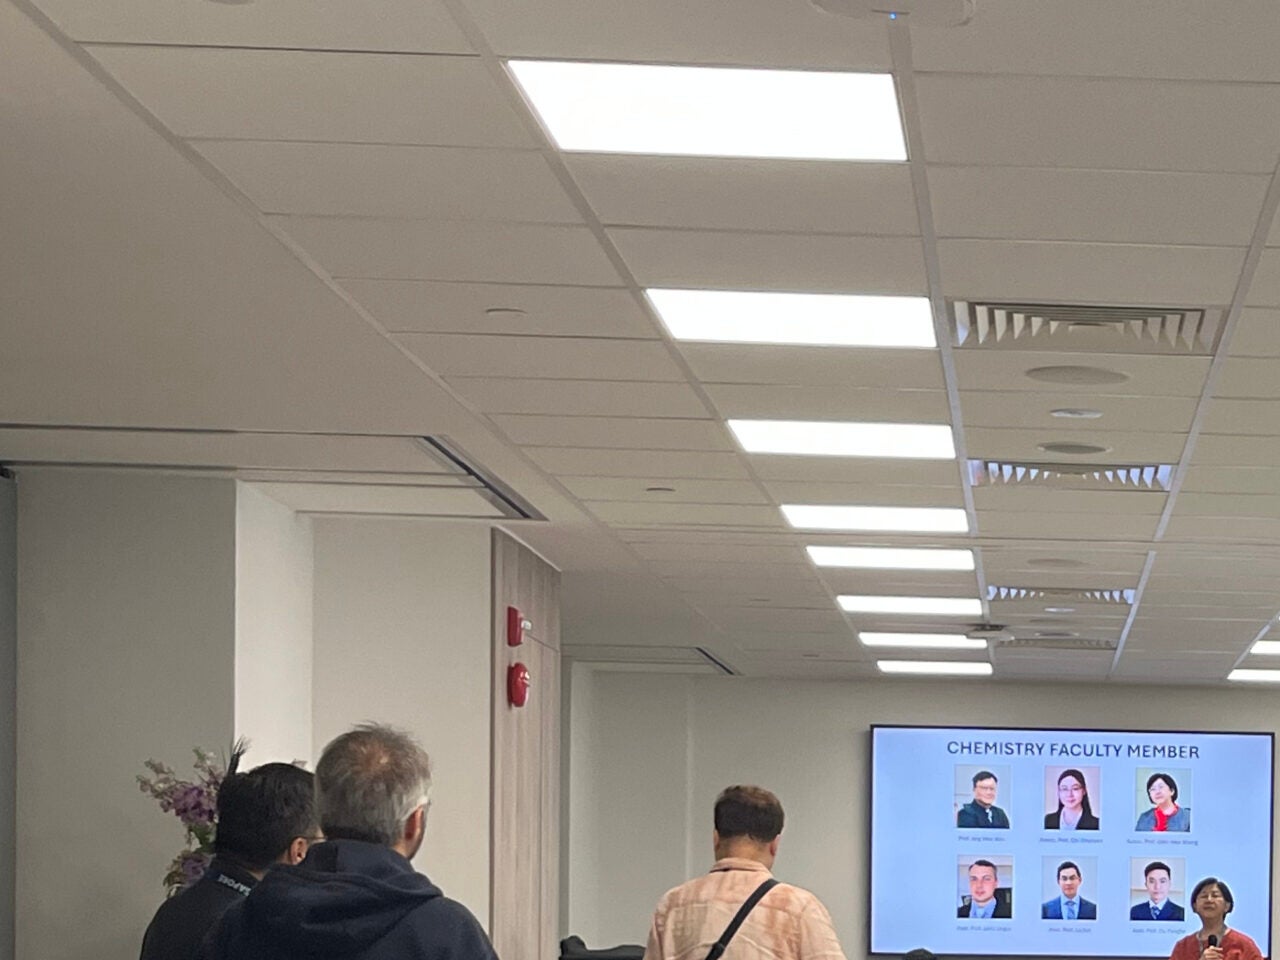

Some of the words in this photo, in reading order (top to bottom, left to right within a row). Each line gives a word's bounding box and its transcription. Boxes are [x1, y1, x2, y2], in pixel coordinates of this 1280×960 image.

[947, 741, 1045, 757] CHEMISTRY
[1050, 743, 1122, 758] FACULTY
[1127, 745, 1199, 759] MEMBER
